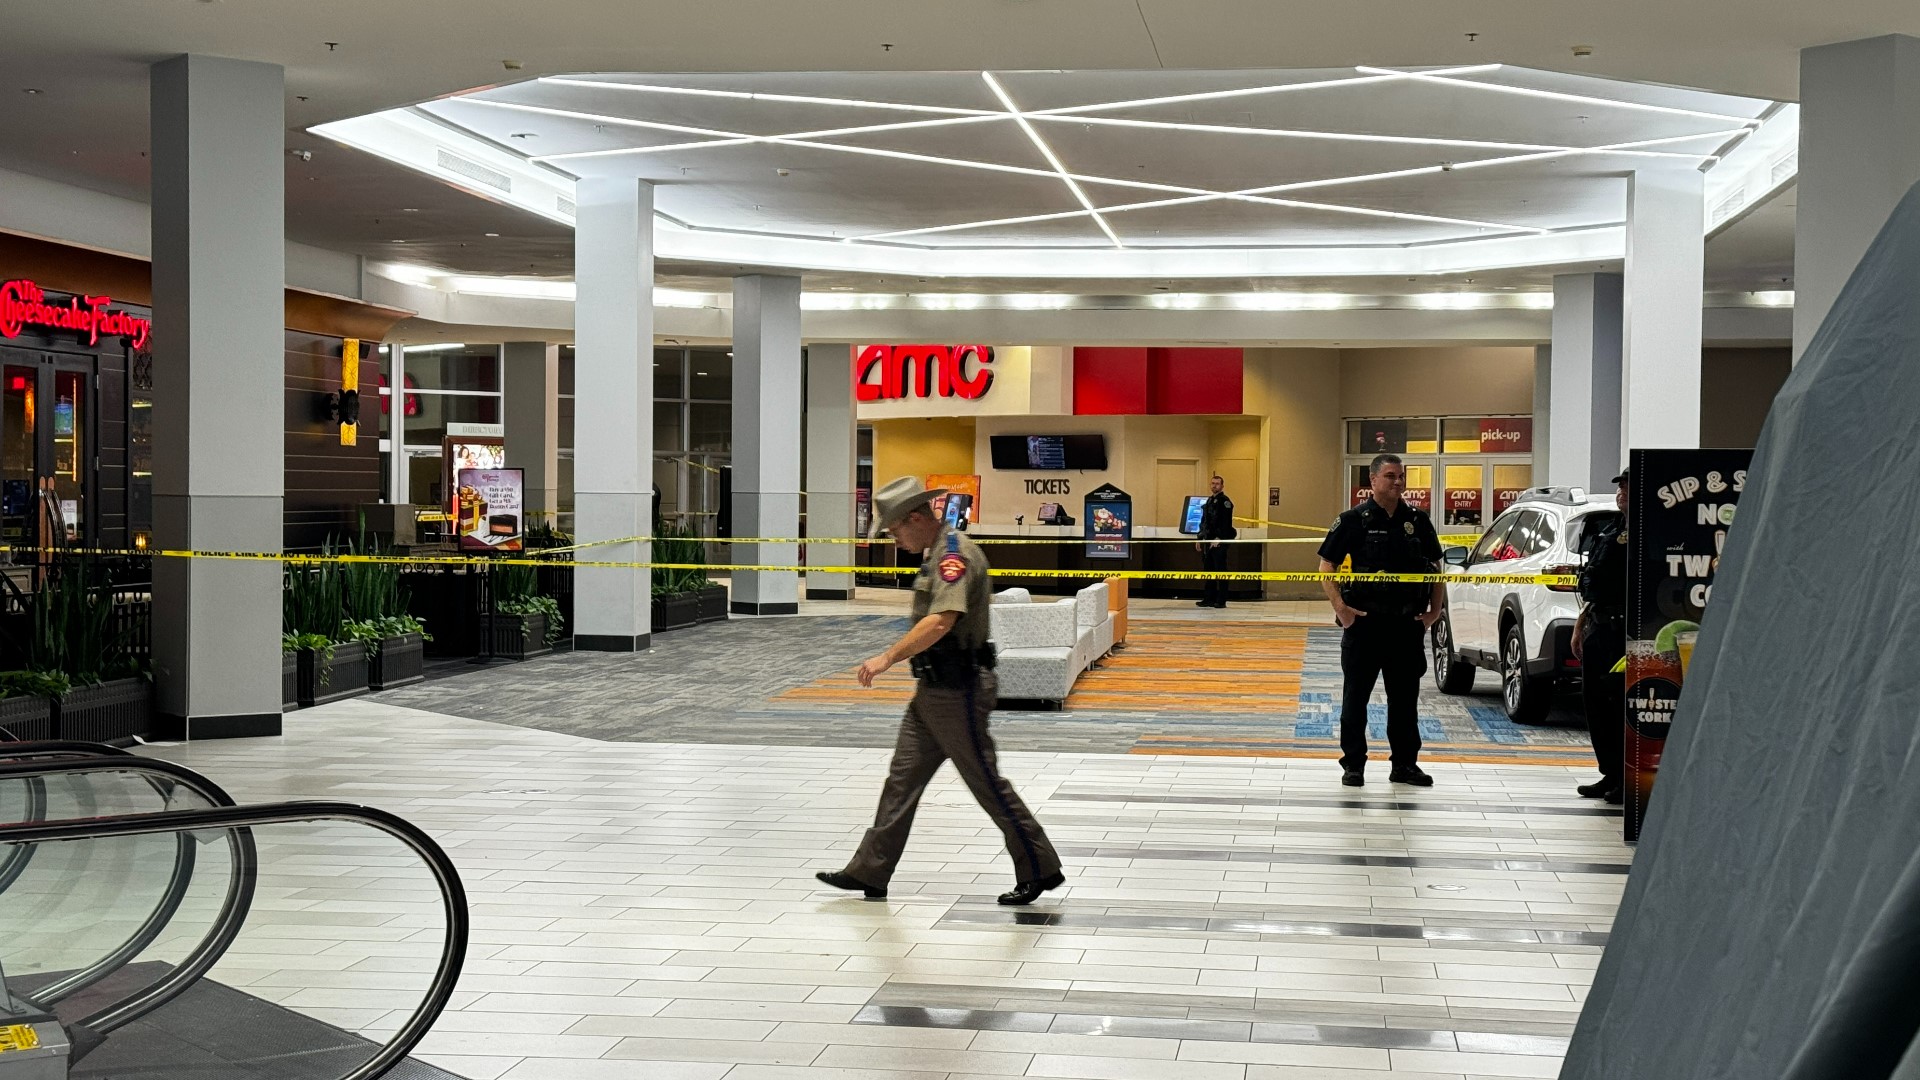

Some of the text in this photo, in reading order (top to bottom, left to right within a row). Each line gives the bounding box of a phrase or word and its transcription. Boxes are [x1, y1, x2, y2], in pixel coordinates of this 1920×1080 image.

[20, 280, 44, 302] The
[0, 280, 150, 350] Cheesecake Factory
[1481, 428, 1521, 443] pick-up
[1024, 478, 1070, 495] TICKETS
[1657, 470, 1747, 509] SIP & S
[1356, 489, 1374, 498] am
[1401, 489, 1426, 499] amc
[1451, 490, 1477, 500] amc
[1697, 503, 1737, 525] NO
[1286, 574, 1316, 582] POLICE
[1318, 574, 1337, 582] LINE
[1373, 575, 1401, 583] CROSS
[1423, 575, 1535, 584] POLICE LINE DO NOT CROSS
[1557, 576, 1579, 585] POLI
[1627, 689, 1678, 710] TWISTE
[1637, 711, 1673, 723] CORK
